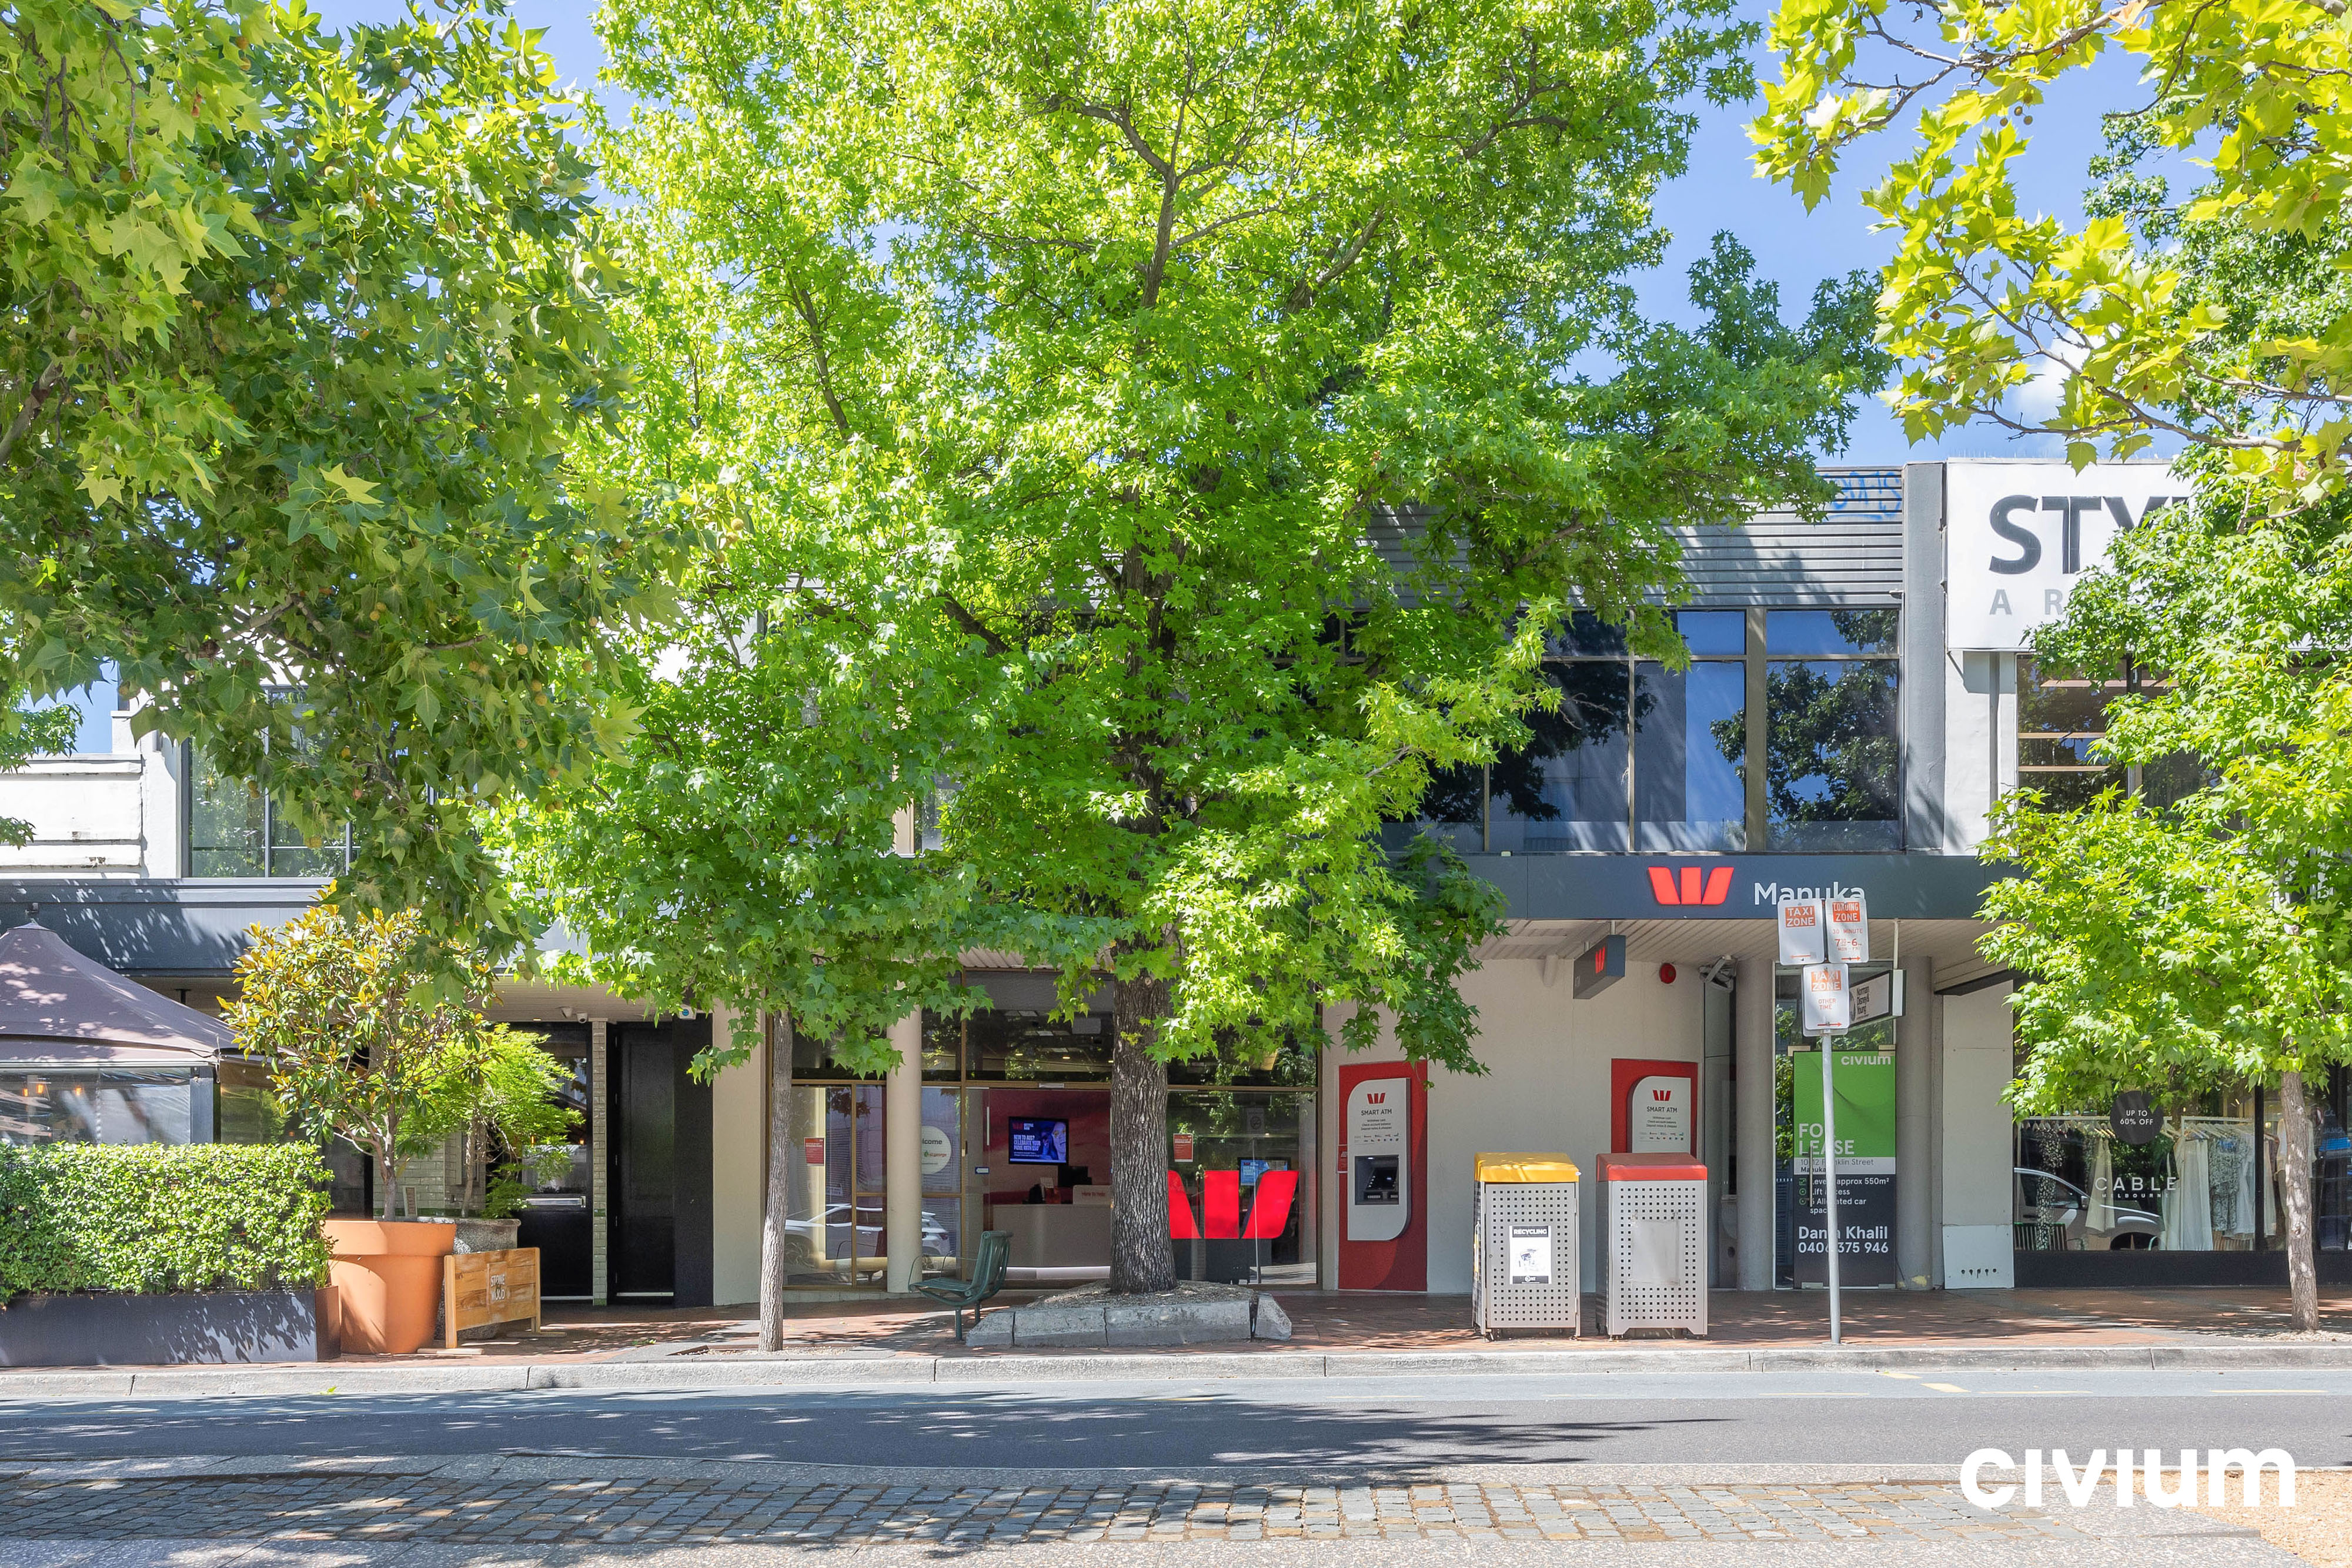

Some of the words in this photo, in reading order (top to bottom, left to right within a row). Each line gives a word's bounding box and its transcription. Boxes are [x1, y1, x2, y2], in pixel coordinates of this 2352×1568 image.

[1989, 494, 2190, 574] STY
[1990, 589, 2063, 615] AR
[1755, 882, 1865, 905] Manuka
[1788, 907, 1813, 916] TAXI
[1786, 917, 1815, 927] ZONE
[1836, 913, 1858, 921] ZONE
[1813, 972, 1839, 981] TAXI
[1813, 982, 1840, 991] ZONE
[1841, 1055, 1891, 1065] civium
[1799, 1123, 1825, 1138] FO
[1837, 1178, 1862, 1186] approx
[2095, 1176, 2176, 1191] CABLE
[1846, 1226, 1888, 1239] Khalil
[1838, 1242, 1860, 1253] 375
[1865, 1242, 1889, 1253] 946
